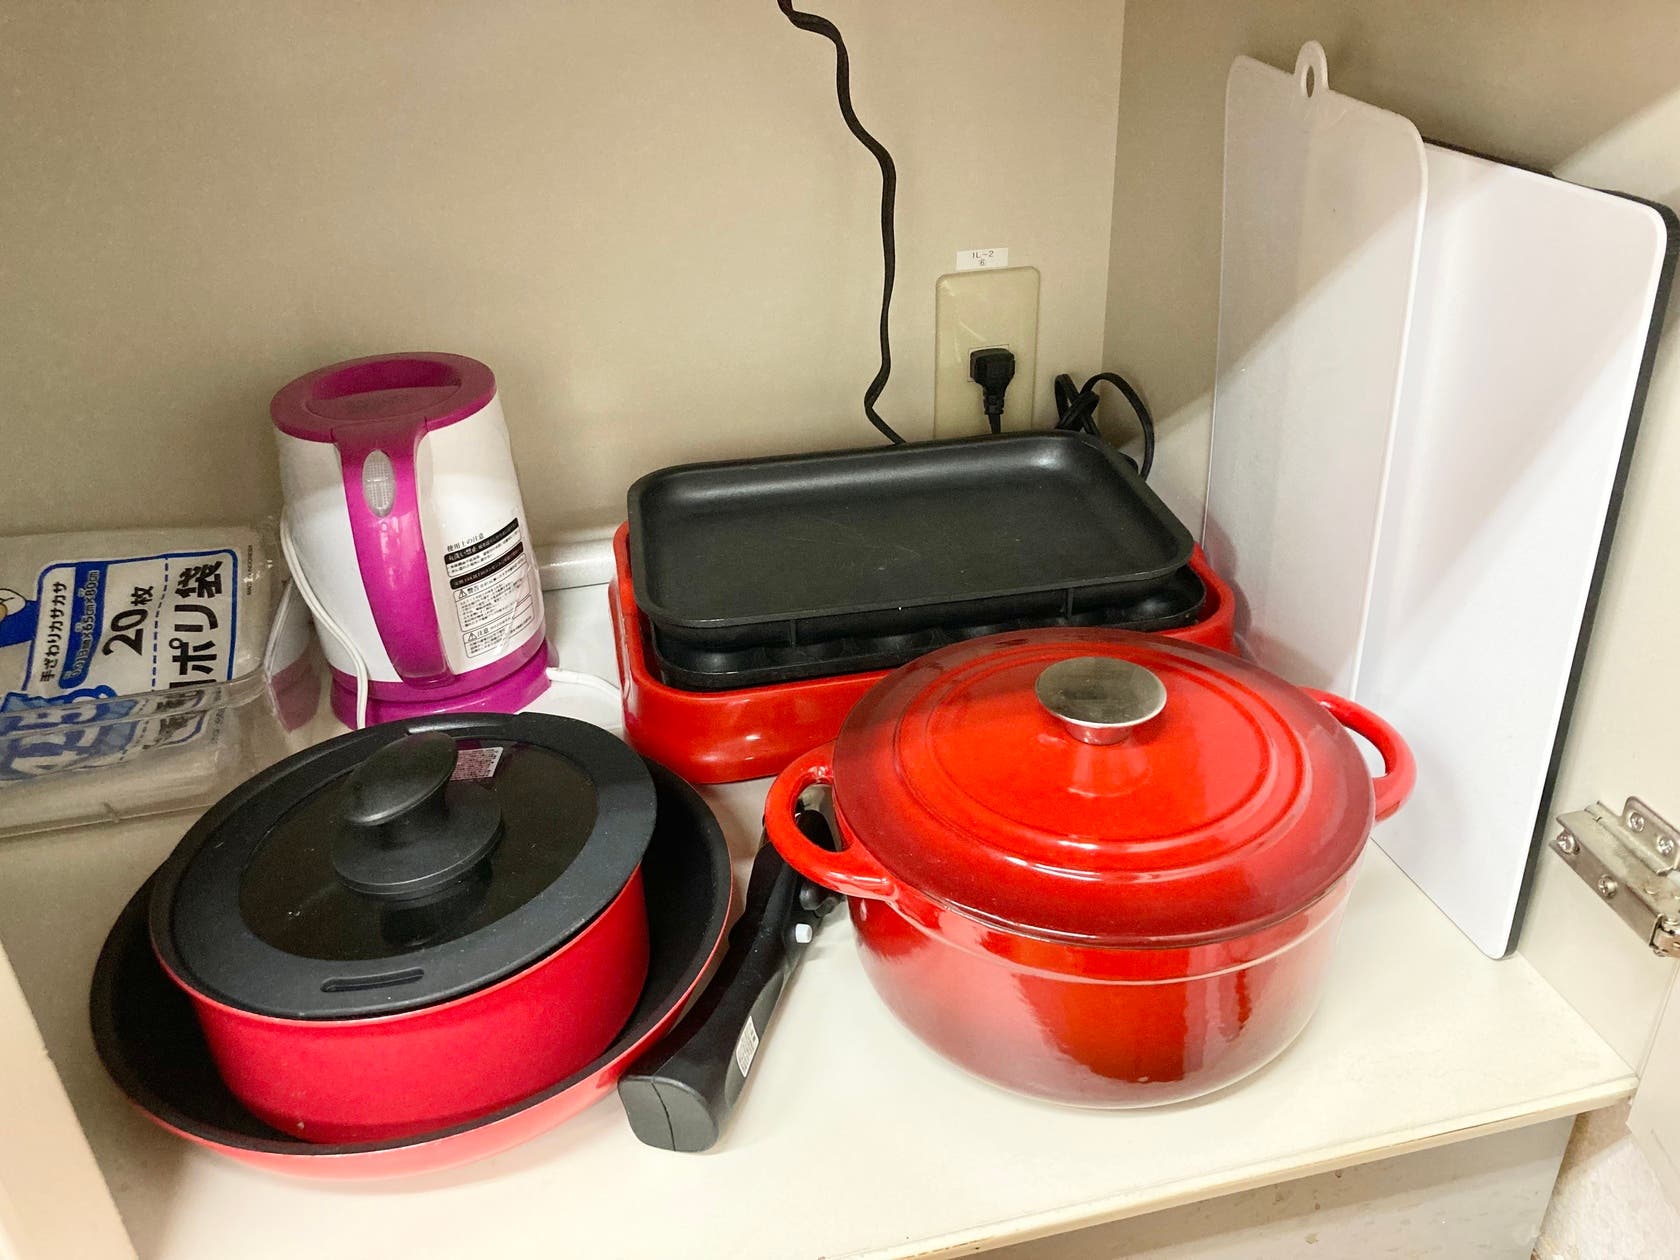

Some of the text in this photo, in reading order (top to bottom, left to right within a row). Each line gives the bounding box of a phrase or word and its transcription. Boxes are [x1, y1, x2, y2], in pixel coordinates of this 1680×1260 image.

[40, 581, 67, 682] 手ざわりカサカサ
[102, 586, 154, 656] 20枚
[169, 561, 223, 688] ポリ袋
